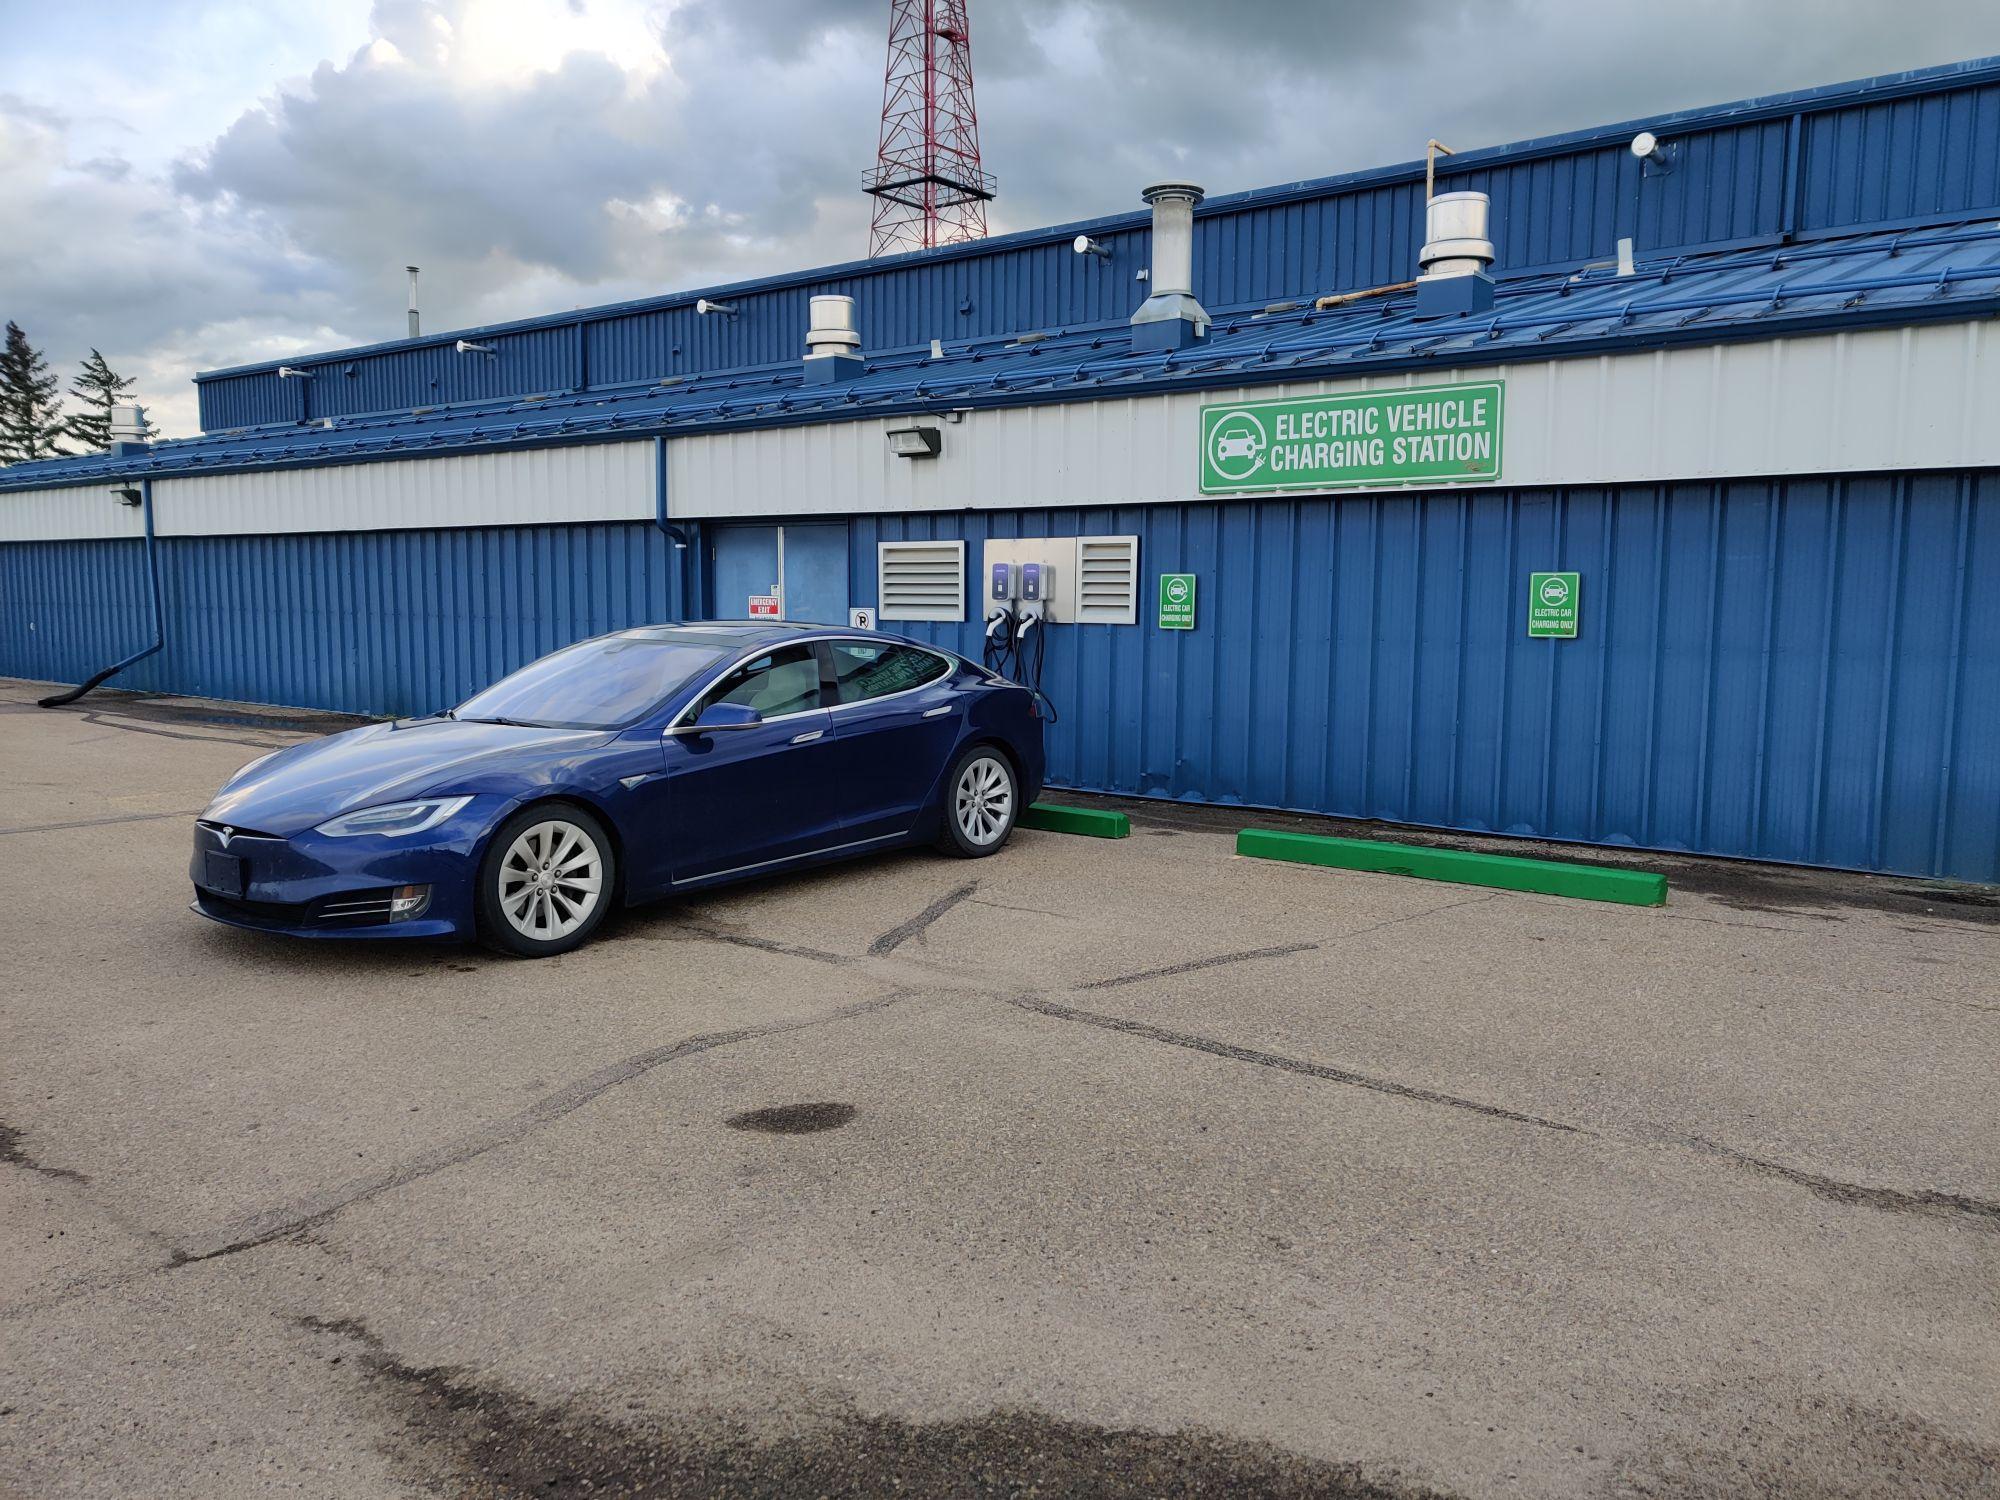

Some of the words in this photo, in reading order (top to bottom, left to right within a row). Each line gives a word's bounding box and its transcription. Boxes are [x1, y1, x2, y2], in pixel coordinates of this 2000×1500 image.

[1276, 407, 1379, 441] ELECTRIC
[1386, 398, 1487, 433] VEHICLE
[1270, 438, 1385, 472] CHARGING
[1392, 431, 1491, 465] STATION
[750, 597, 778, 606] EMERGENCY
[757, 605, 771, 614] EXIT
[1534, 608, 1560, 617] ELECTRIC
[1560, 608, 1572, 617] CAR
[1531, 619, 1560, 629] CHARGING
[1560, 620, 1574, 629] ONLY
